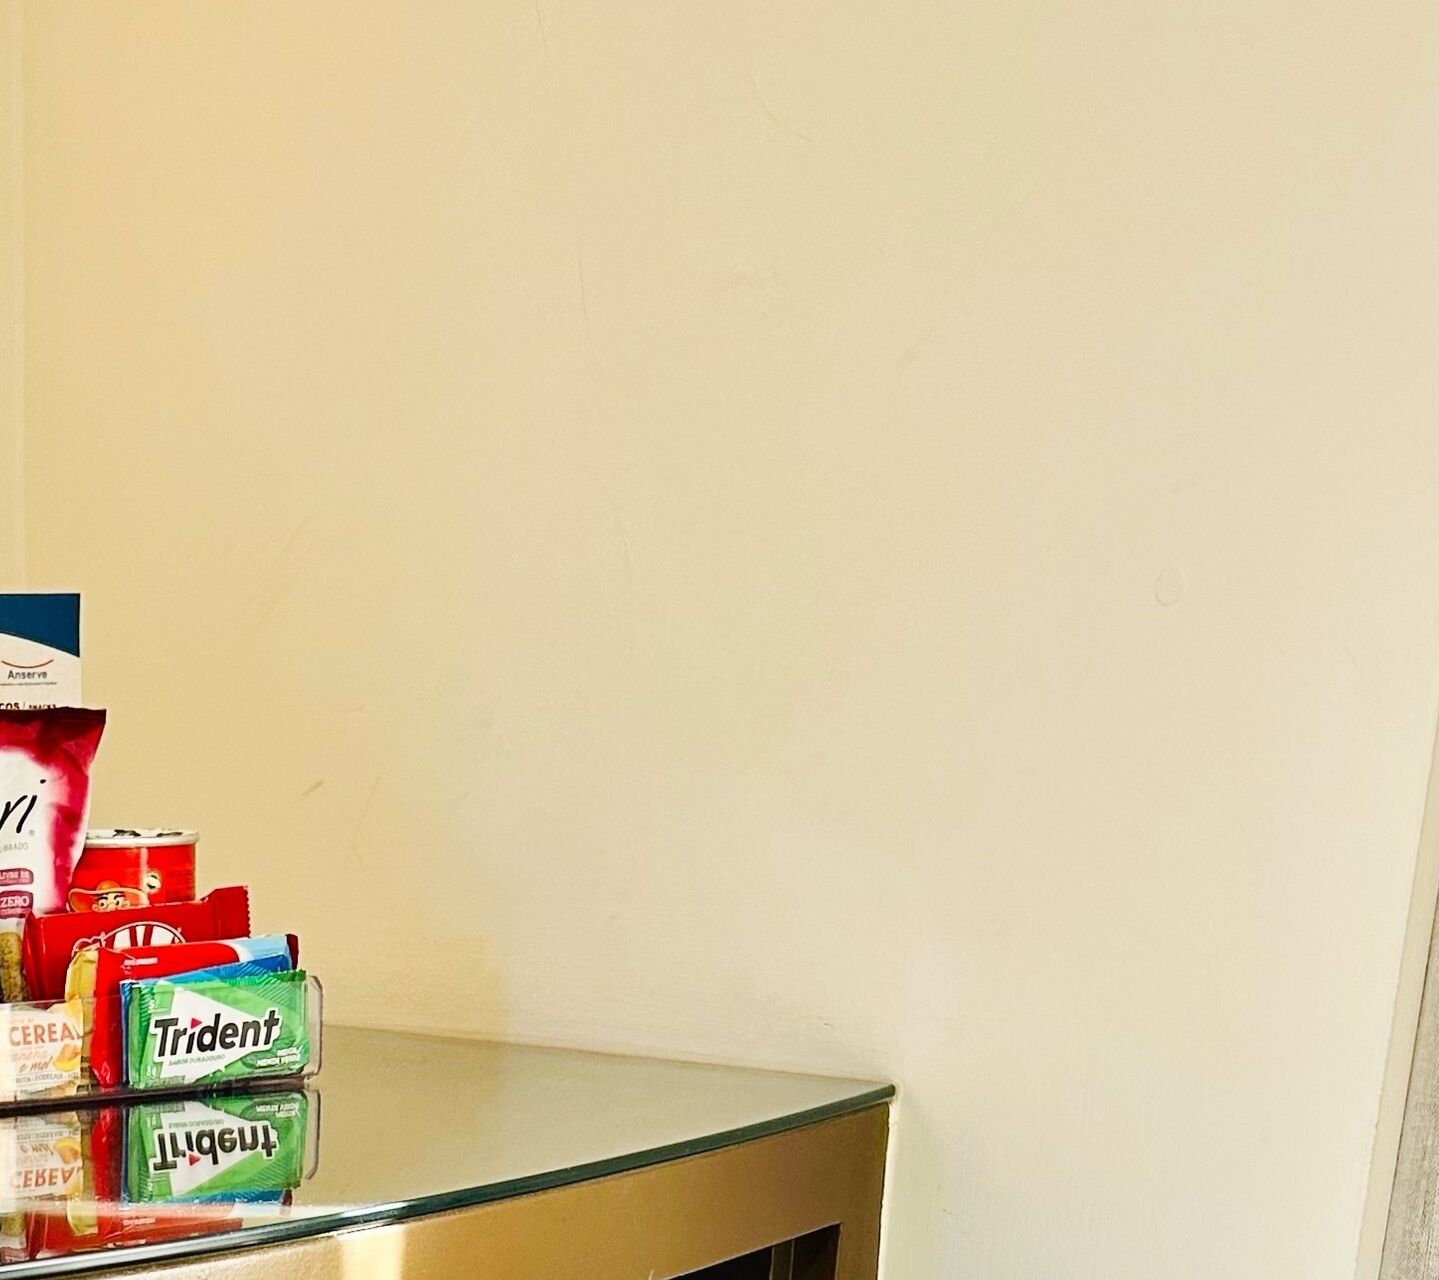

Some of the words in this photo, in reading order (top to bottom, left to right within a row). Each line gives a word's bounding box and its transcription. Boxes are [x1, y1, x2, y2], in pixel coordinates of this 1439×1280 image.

[7, 670, 48, 680] Anserve
[0, 895, 31, 908] ZERO
[9, 1021, 81, 1047] CEREA
[154, 1009, 280, 1059] Trident
